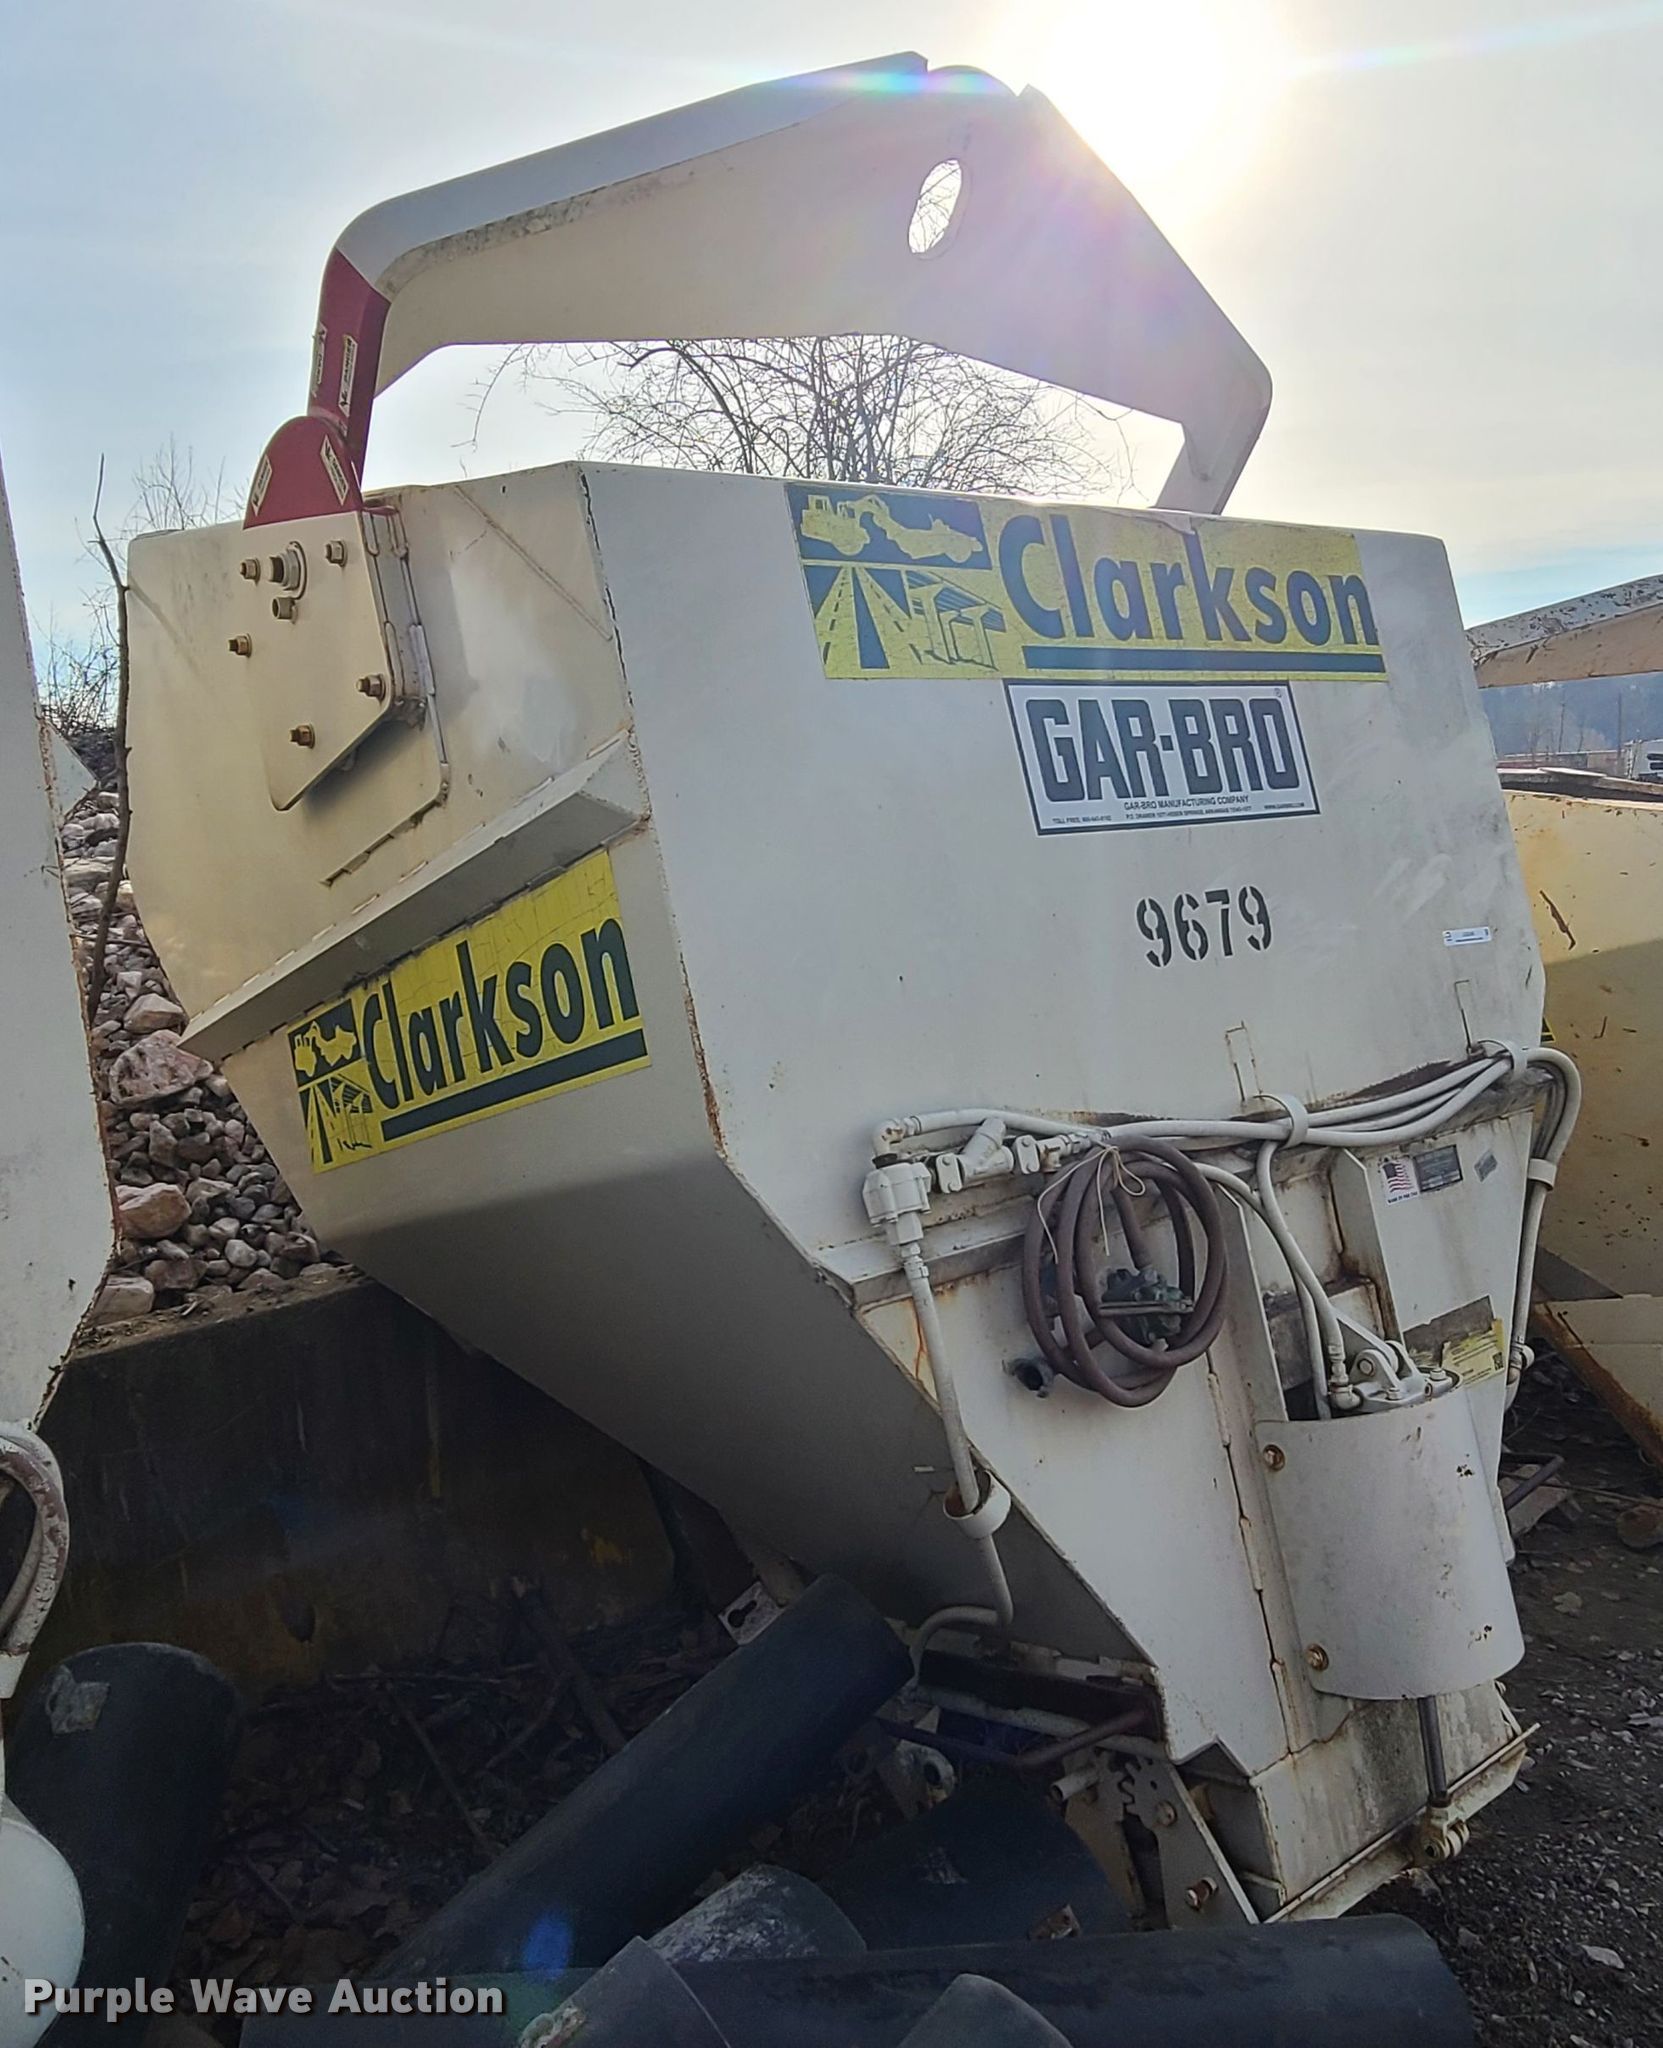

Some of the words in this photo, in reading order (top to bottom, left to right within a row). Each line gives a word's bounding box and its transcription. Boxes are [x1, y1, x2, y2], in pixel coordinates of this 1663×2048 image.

[999, 515, 1379, 646] Clarkson
[1026, 698, 1300, 803] GAR-BRO
[1136, 886, 1272, 968] 9679
[362, 918, 640, 1109] Clarkson
